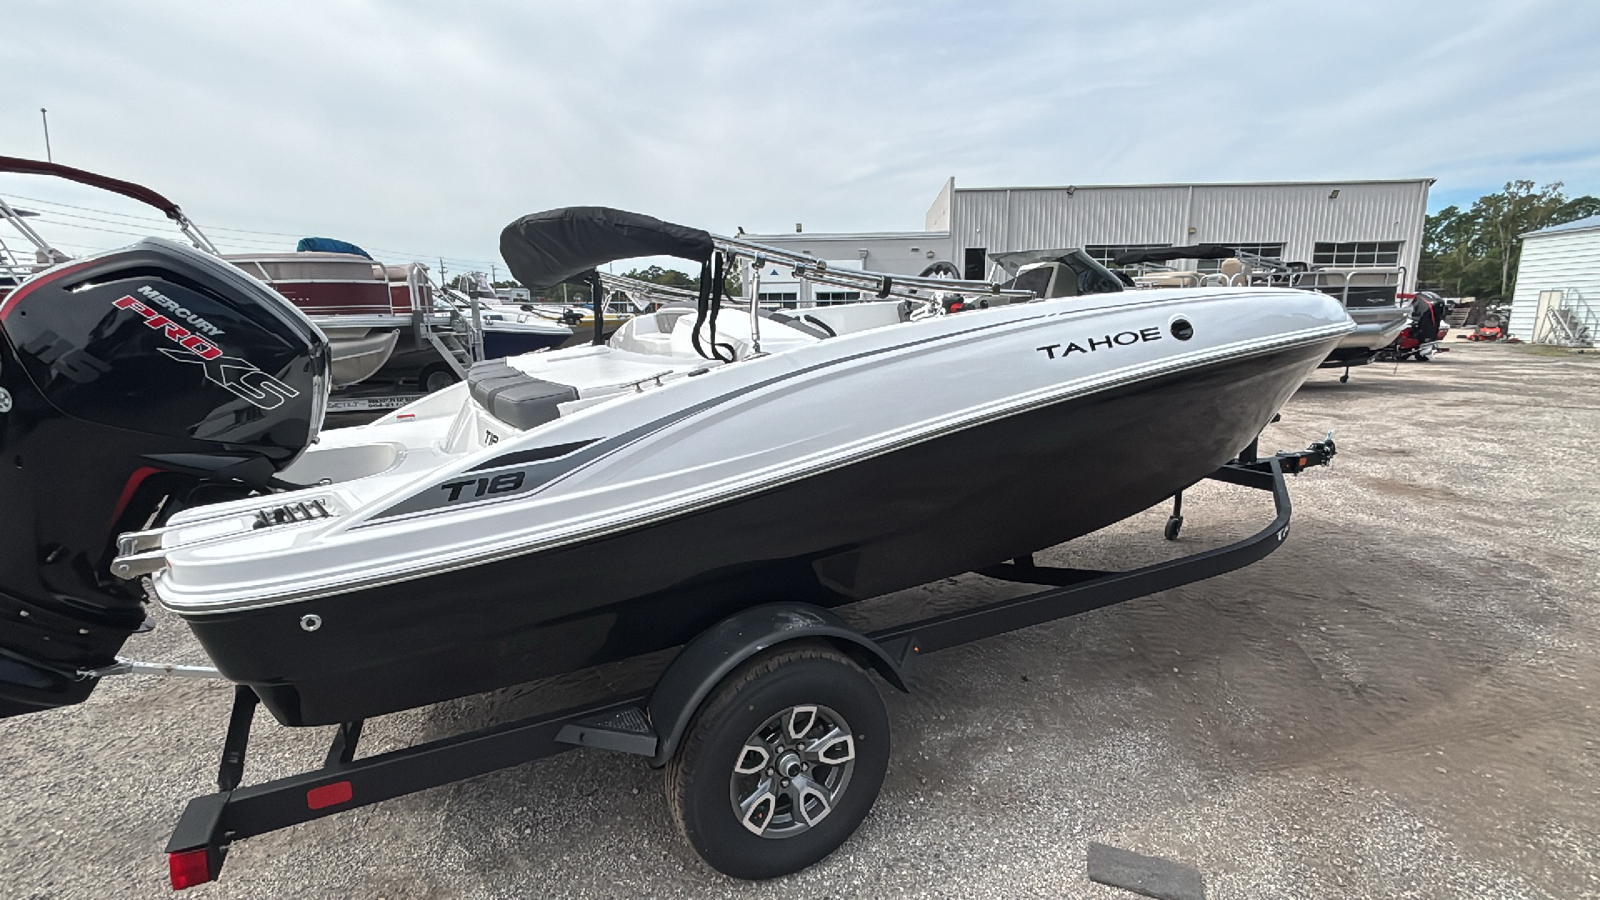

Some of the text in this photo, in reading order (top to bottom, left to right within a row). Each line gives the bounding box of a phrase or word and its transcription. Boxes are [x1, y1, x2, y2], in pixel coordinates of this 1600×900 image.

[112, 294, 223, 360] PRO
[137, 285, 226, 336] MERCURY
[1036, 326, 1162, 360] TAHOE
[156, 347, 300, 410] XS
[441, 471, 526, 502] T18
